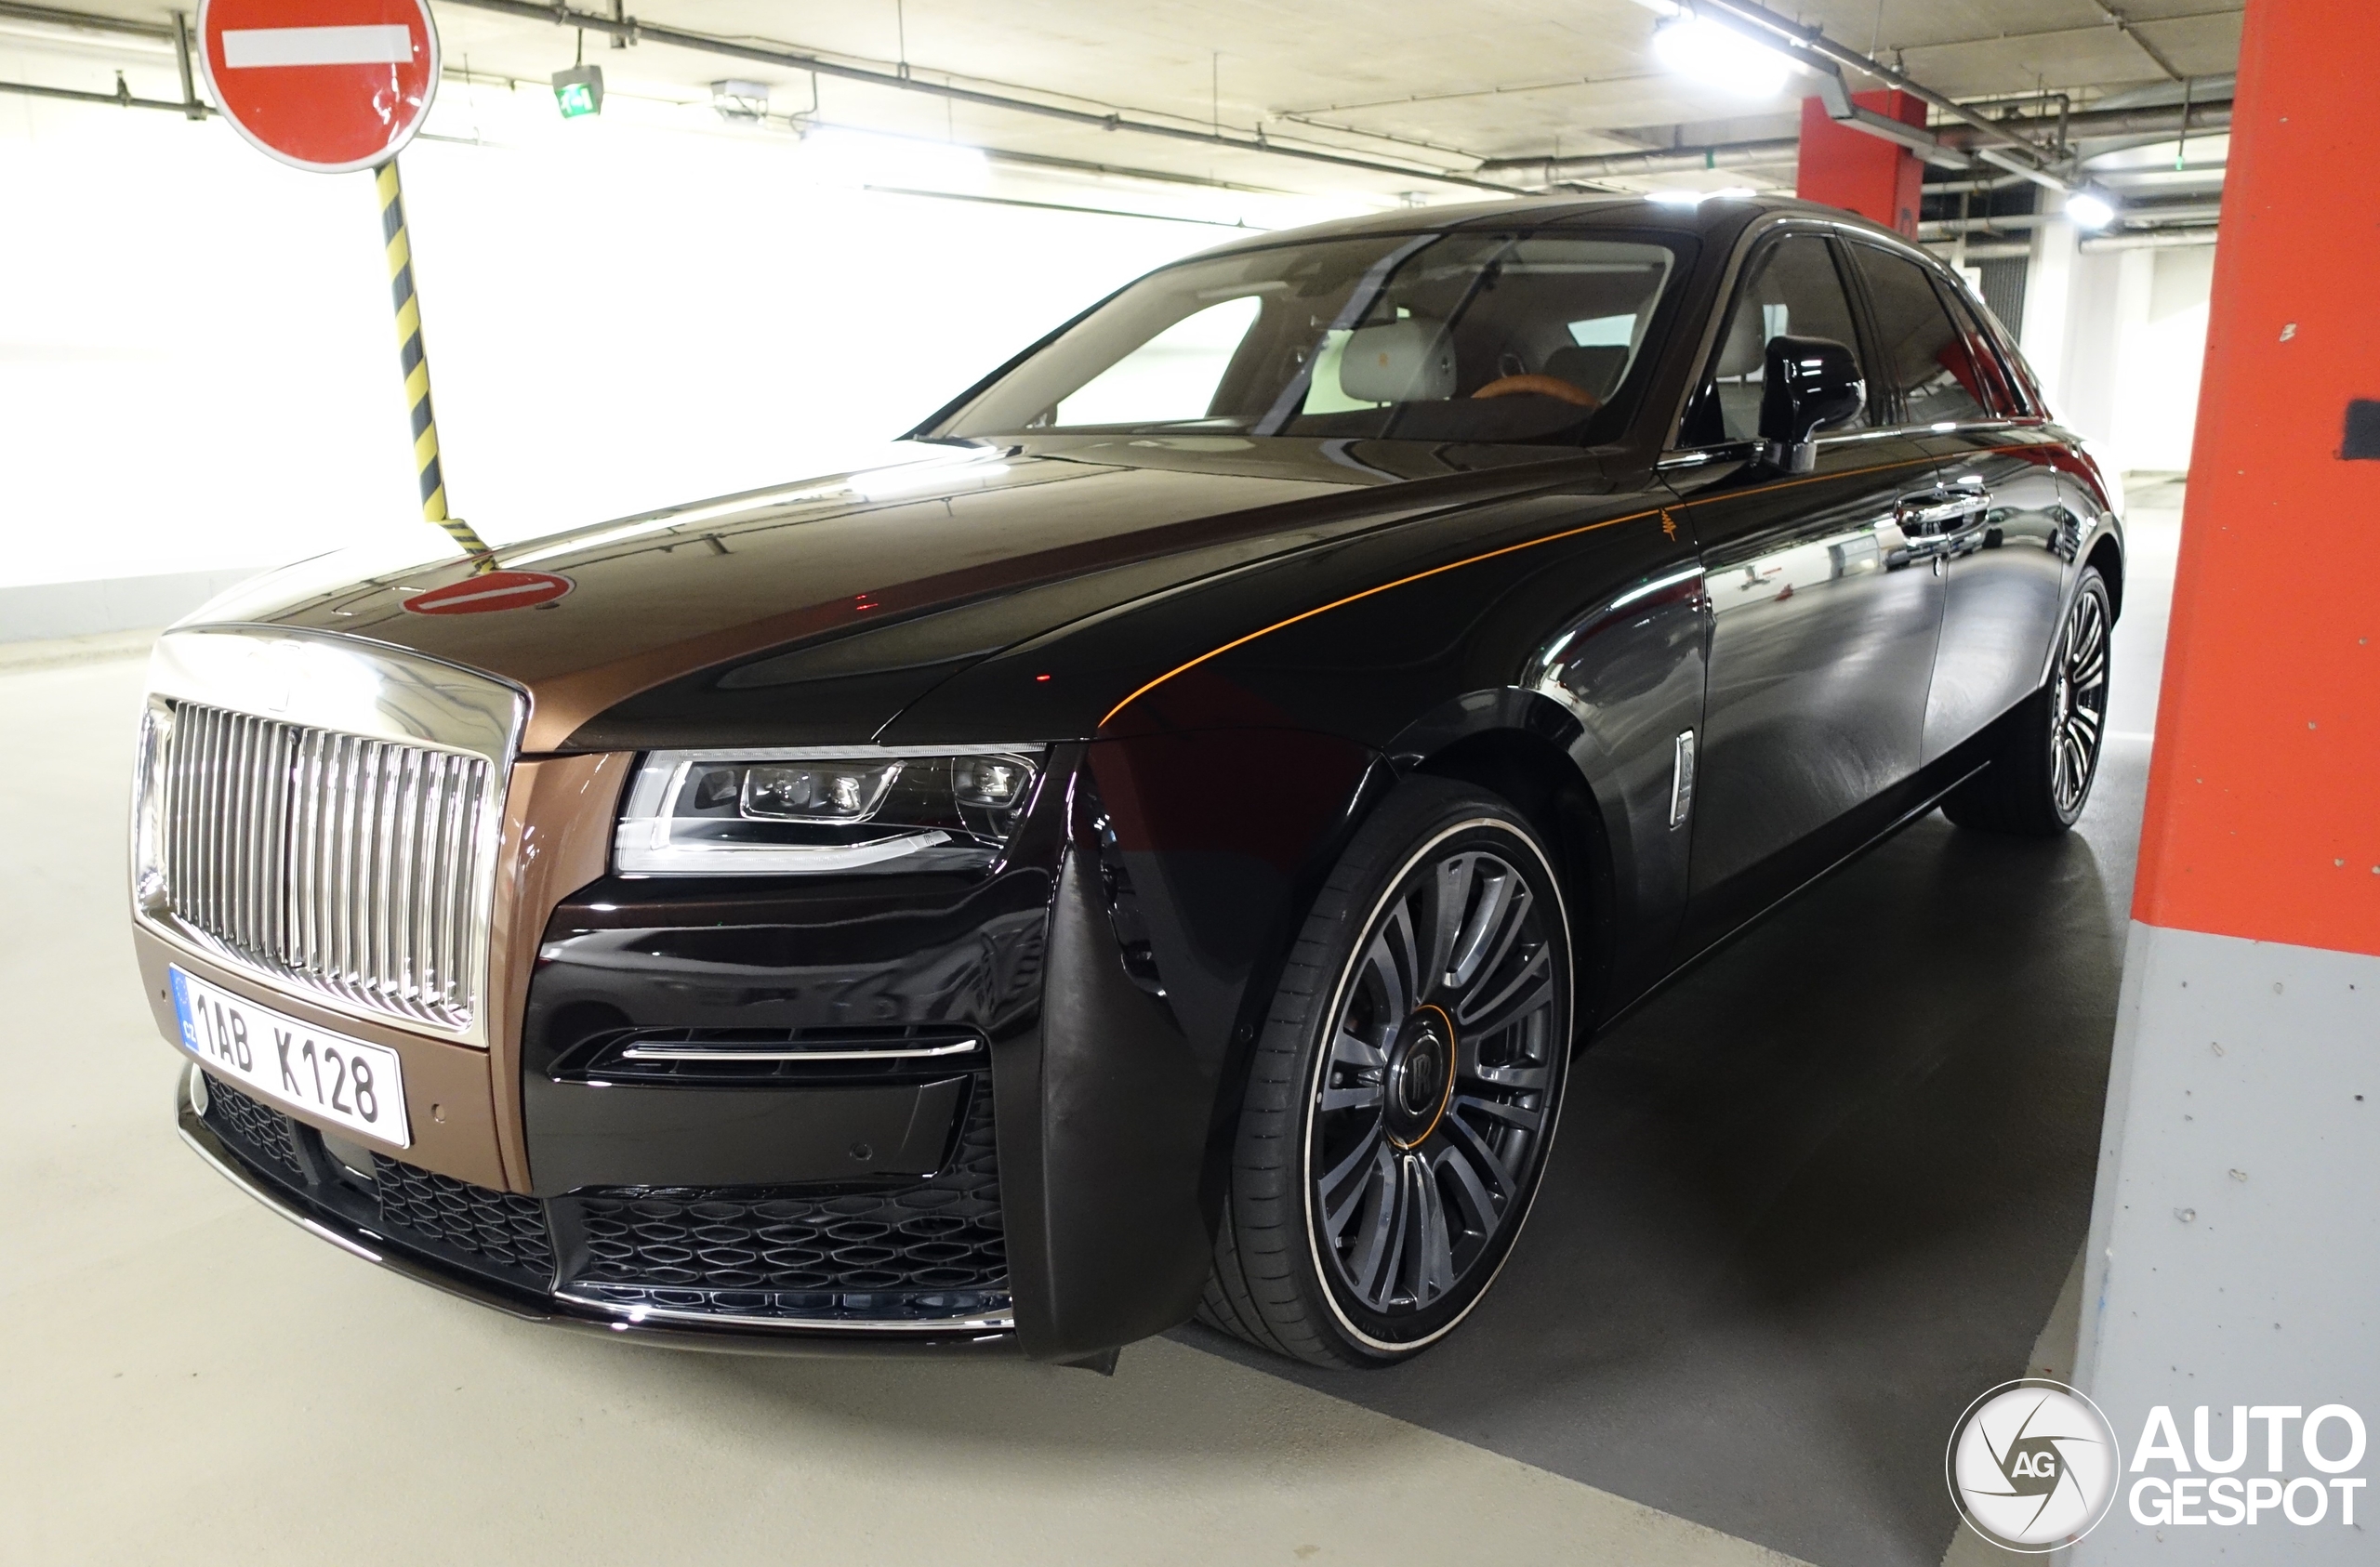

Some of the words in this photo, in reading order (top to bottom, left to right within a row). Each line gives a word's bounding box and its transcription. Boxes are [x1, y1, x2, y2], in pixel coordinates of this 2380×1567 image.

[183, 1021, 197, 1043] CZ
[197, 994, 253, 1073] 1AB
[274, 1027, 378, 1124] K128
